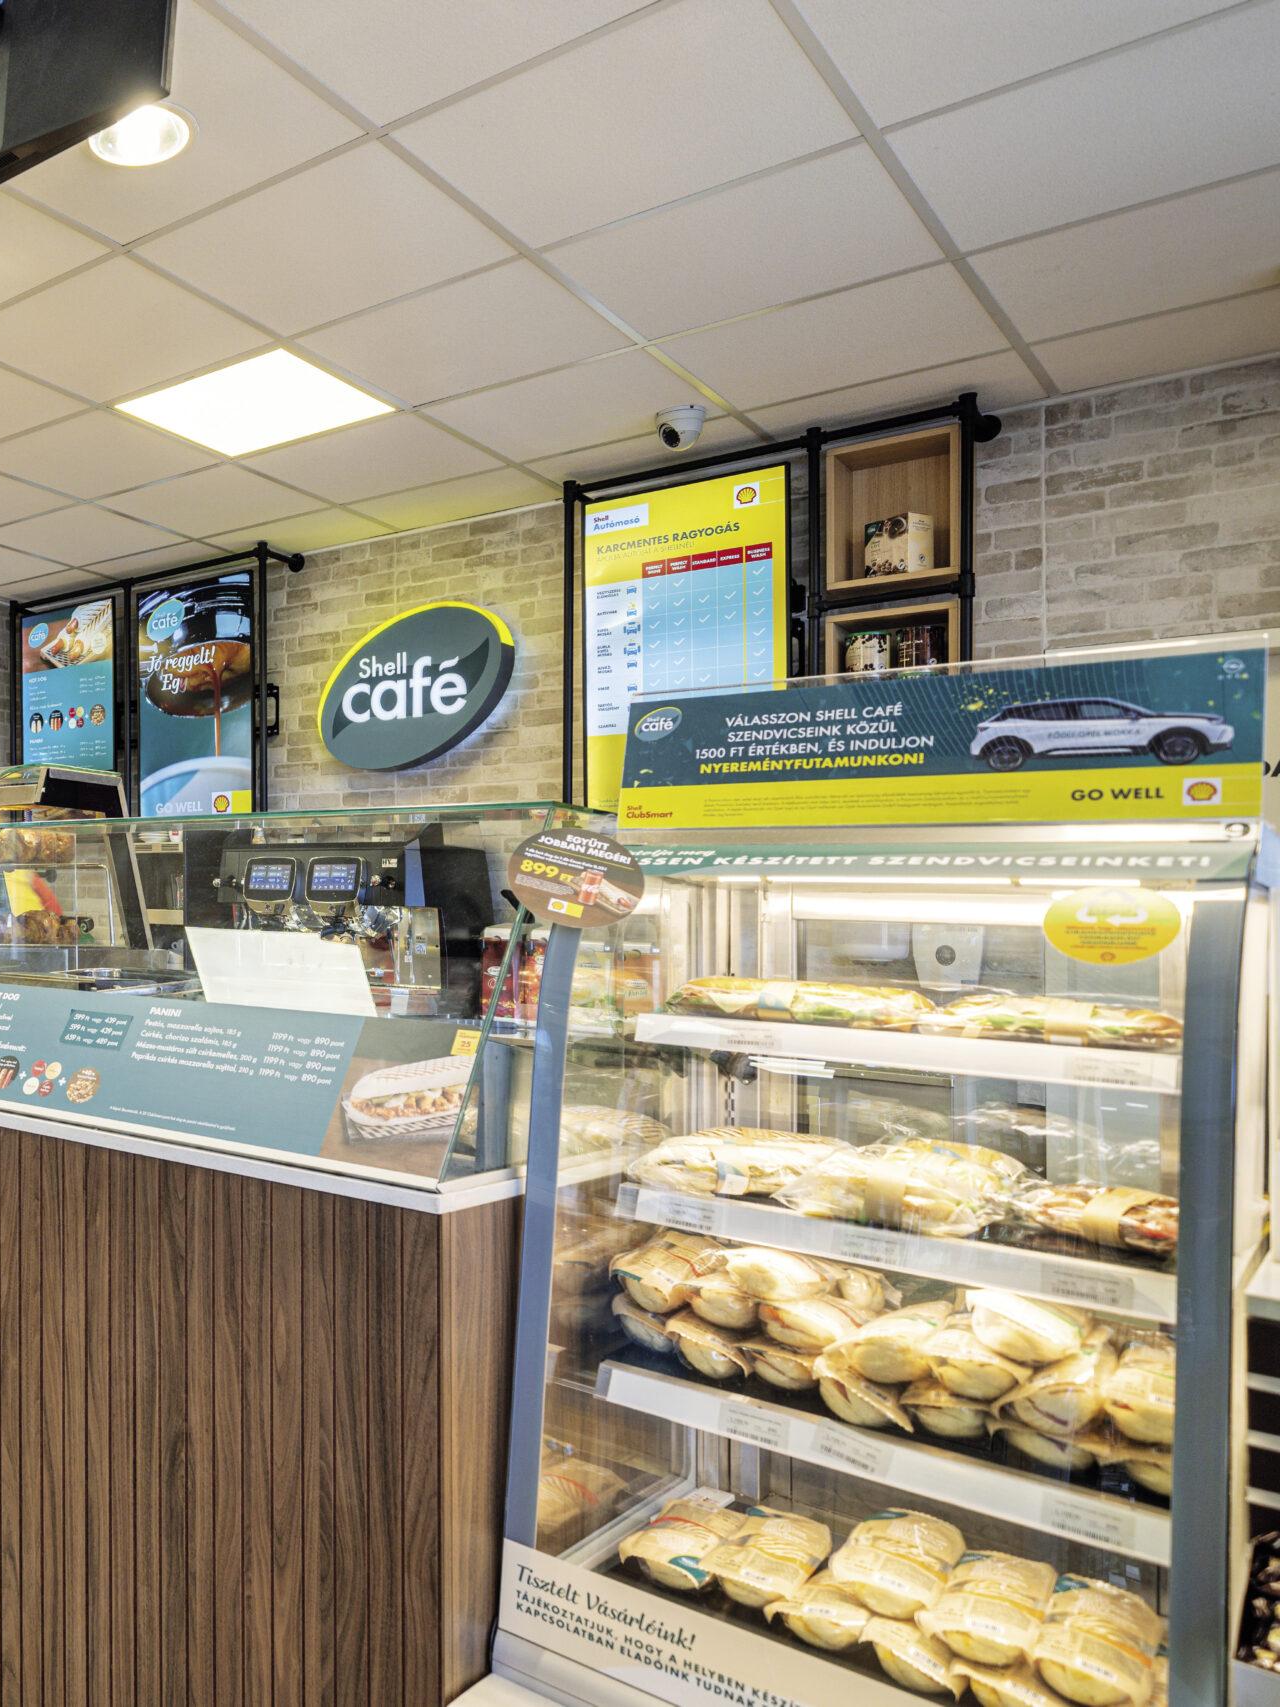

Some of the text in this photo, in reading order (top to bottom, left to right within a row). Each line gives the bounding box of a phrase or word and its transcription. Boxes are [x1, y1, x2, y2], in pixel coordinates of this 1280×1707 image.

[593, 515, 610, 524] Shell
[593, 516, 640, 532] Autómosó
[596, 521, 741, 556] KARCMENTES RAGYOGÁS
[151, 612, 179, 631] café
[147, 646, 216, 674] Jó reggelt!
[358, 652, 408, 679] Shell
[161, 674, 188, 694] Egy
[341, 656, 468, 723] café
[725, 702, 903, 728] VÁLASSZON SHELL CAFÉ
[641, 718, 674, 733] café
[727, 720, 897, 743] SZENDVICSEINK KÖZÜL
[695, 735, 935, 760] 1500 FT ÉRTÉKBEN, ÉS INDULJON
[699, 752, 924, 775] NYEREMÉNYFUTAMUNKON!
[1071, 787, 1165, 801] GO WELL
[155, 801, 203, 815] GO WELL
[626, 810, 673, 820] ClubSmart
[537, 835, 586, 854] JOBBAN
[565, 834, 610, 850] EGYÜTT
[635, 857, 704, 866] SSEN
[713, 853, 858, 866] KÉSZÍTETT
[520, 859, 559, 878] 899
[559, 873, 575, 883] FT
[2, 992, 20, 1000] DOG
[149, 1006, 182, 1018] PANINI
[272, 1032, 288, 1040] 1199
[314, 1036, 330, 1046] 890
[268, 1044, 284, 1052] 1199
[310, 1048, 326, 1058] 890
[263, 1056, 280, 1064] 1199
[305, 1060, 322, 1070] 890
[259, 1068, 275, 1077] 1199
[301, 1073, 318, 1083] 890
[316, 1078, 332, 1086] pont
[516, 1563, 696, 1652] Tisztelt Vásárlóink!
[515, 1587, 618, 1640] TÁJÉKOZTATJUK,
[624, 1634, 664, 1657] HOGY
[669, 1653, 678, 1664] A
[683, 1656, 745, 1692] HELYBEN
[515, 1602, 755, 1707] KAPCSOLATBAN ELADÓINK TUDNAK
